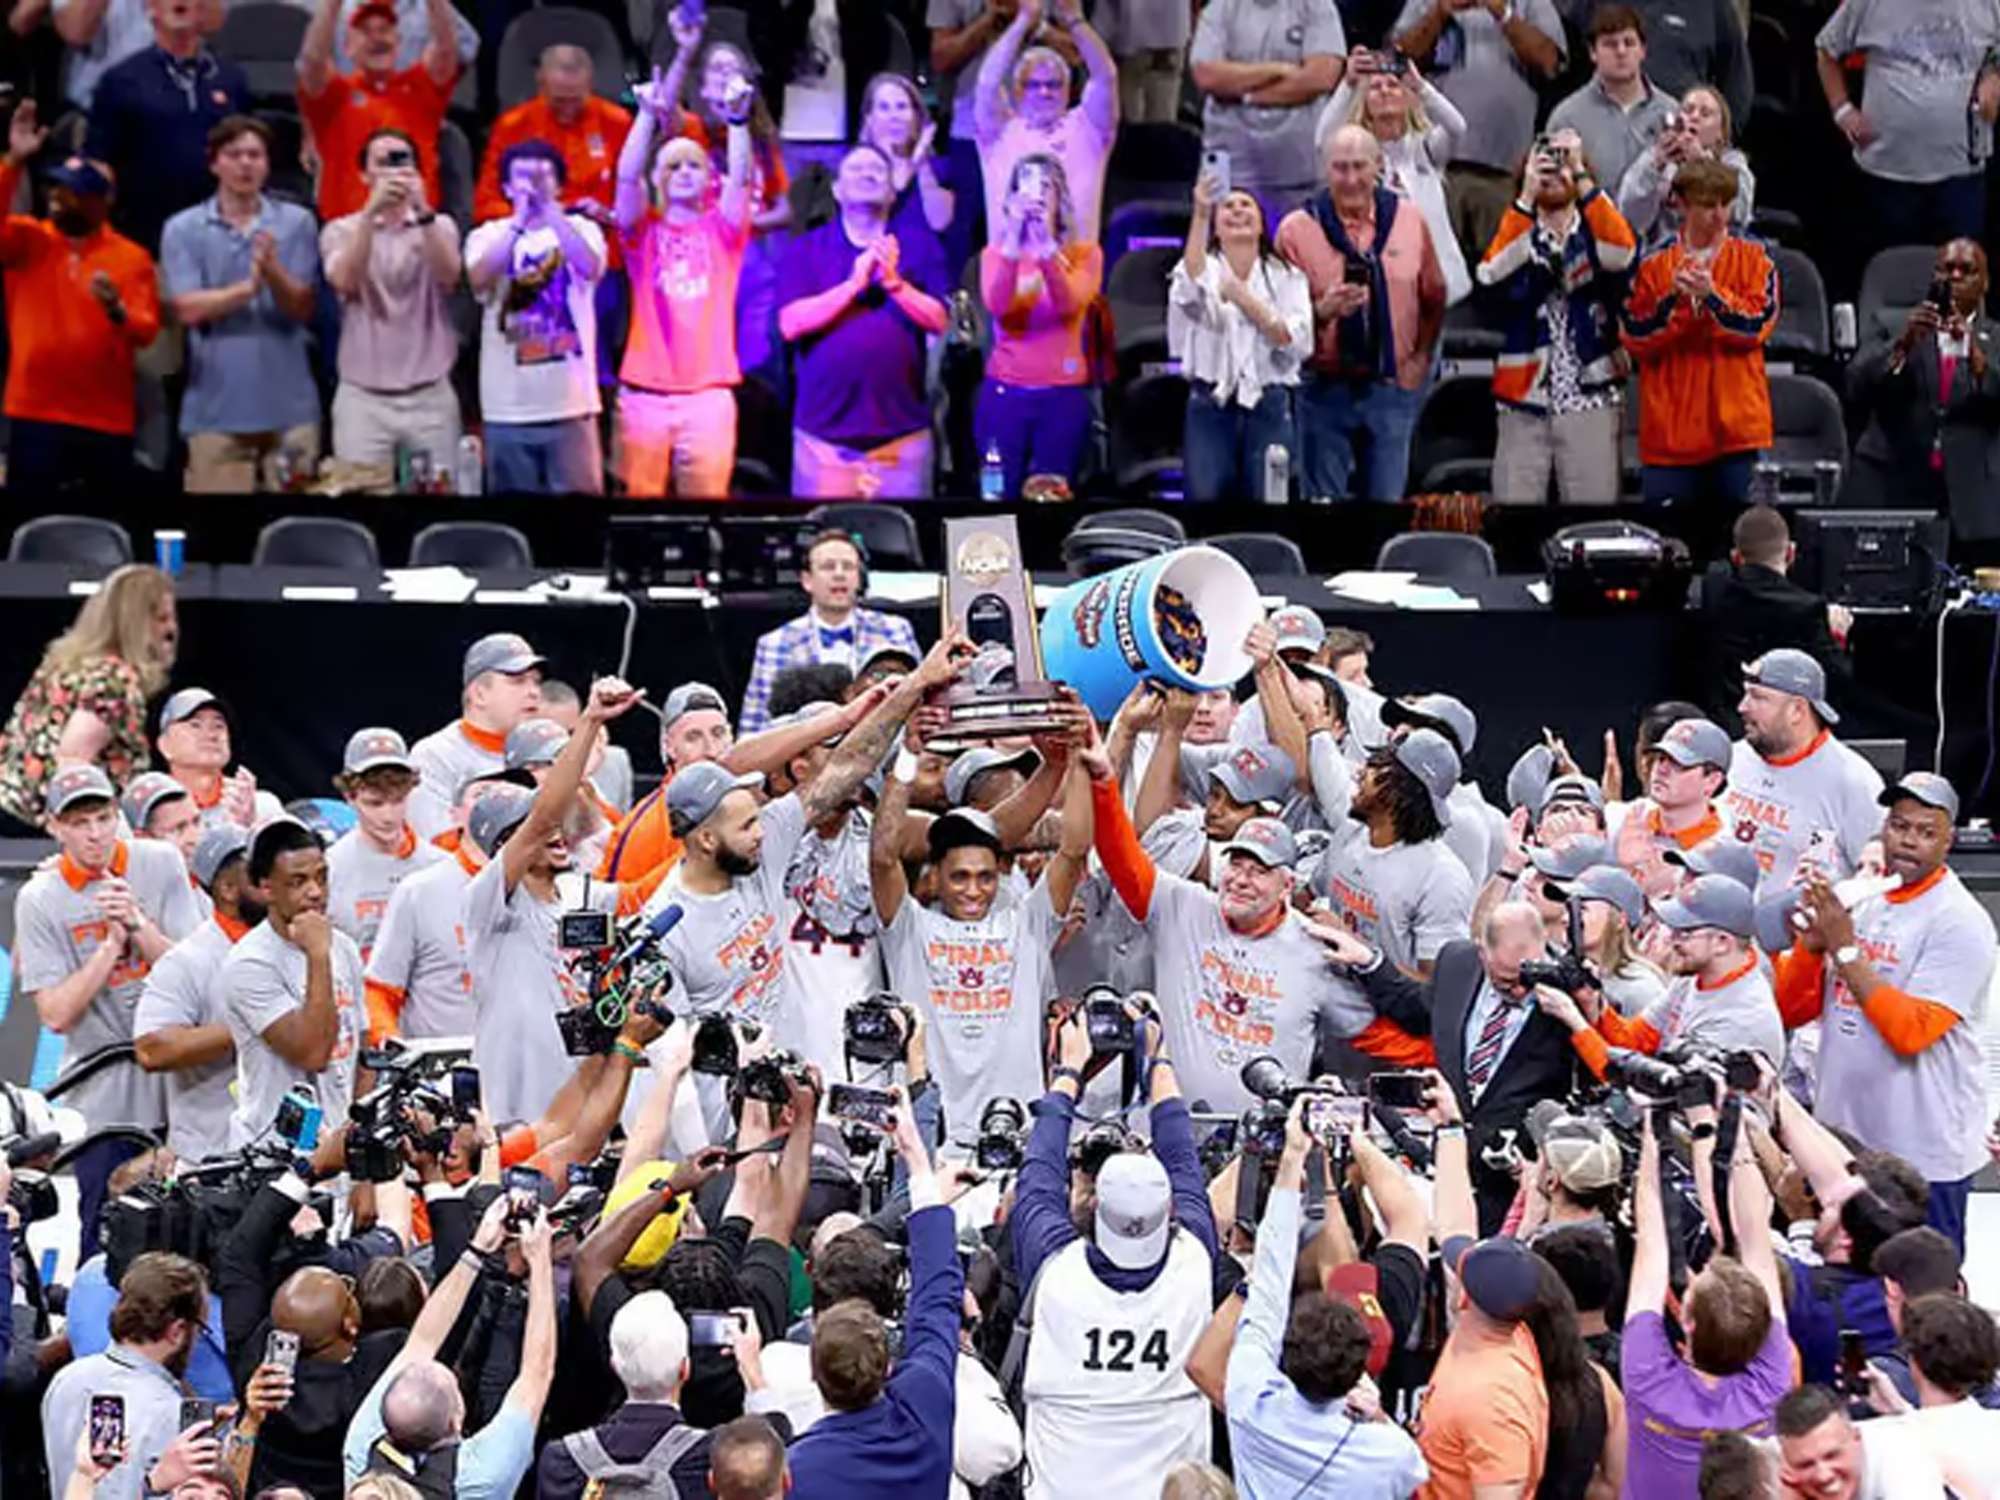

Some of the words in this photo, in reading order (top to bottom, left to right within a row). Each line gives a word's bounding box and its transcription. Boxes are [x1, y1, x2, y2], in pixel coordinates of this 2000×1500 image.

[1727, 791, 1790, 832] FINAL
[928, 943, 1013, 966] FINAL
[1201, 950, 1284, 999] FINAL
[929, 987, 1012, 1011] FOUR
[1194, 1000, 1275, 1047] FOUR
[1083, 1327, 1169, 1372] 124
